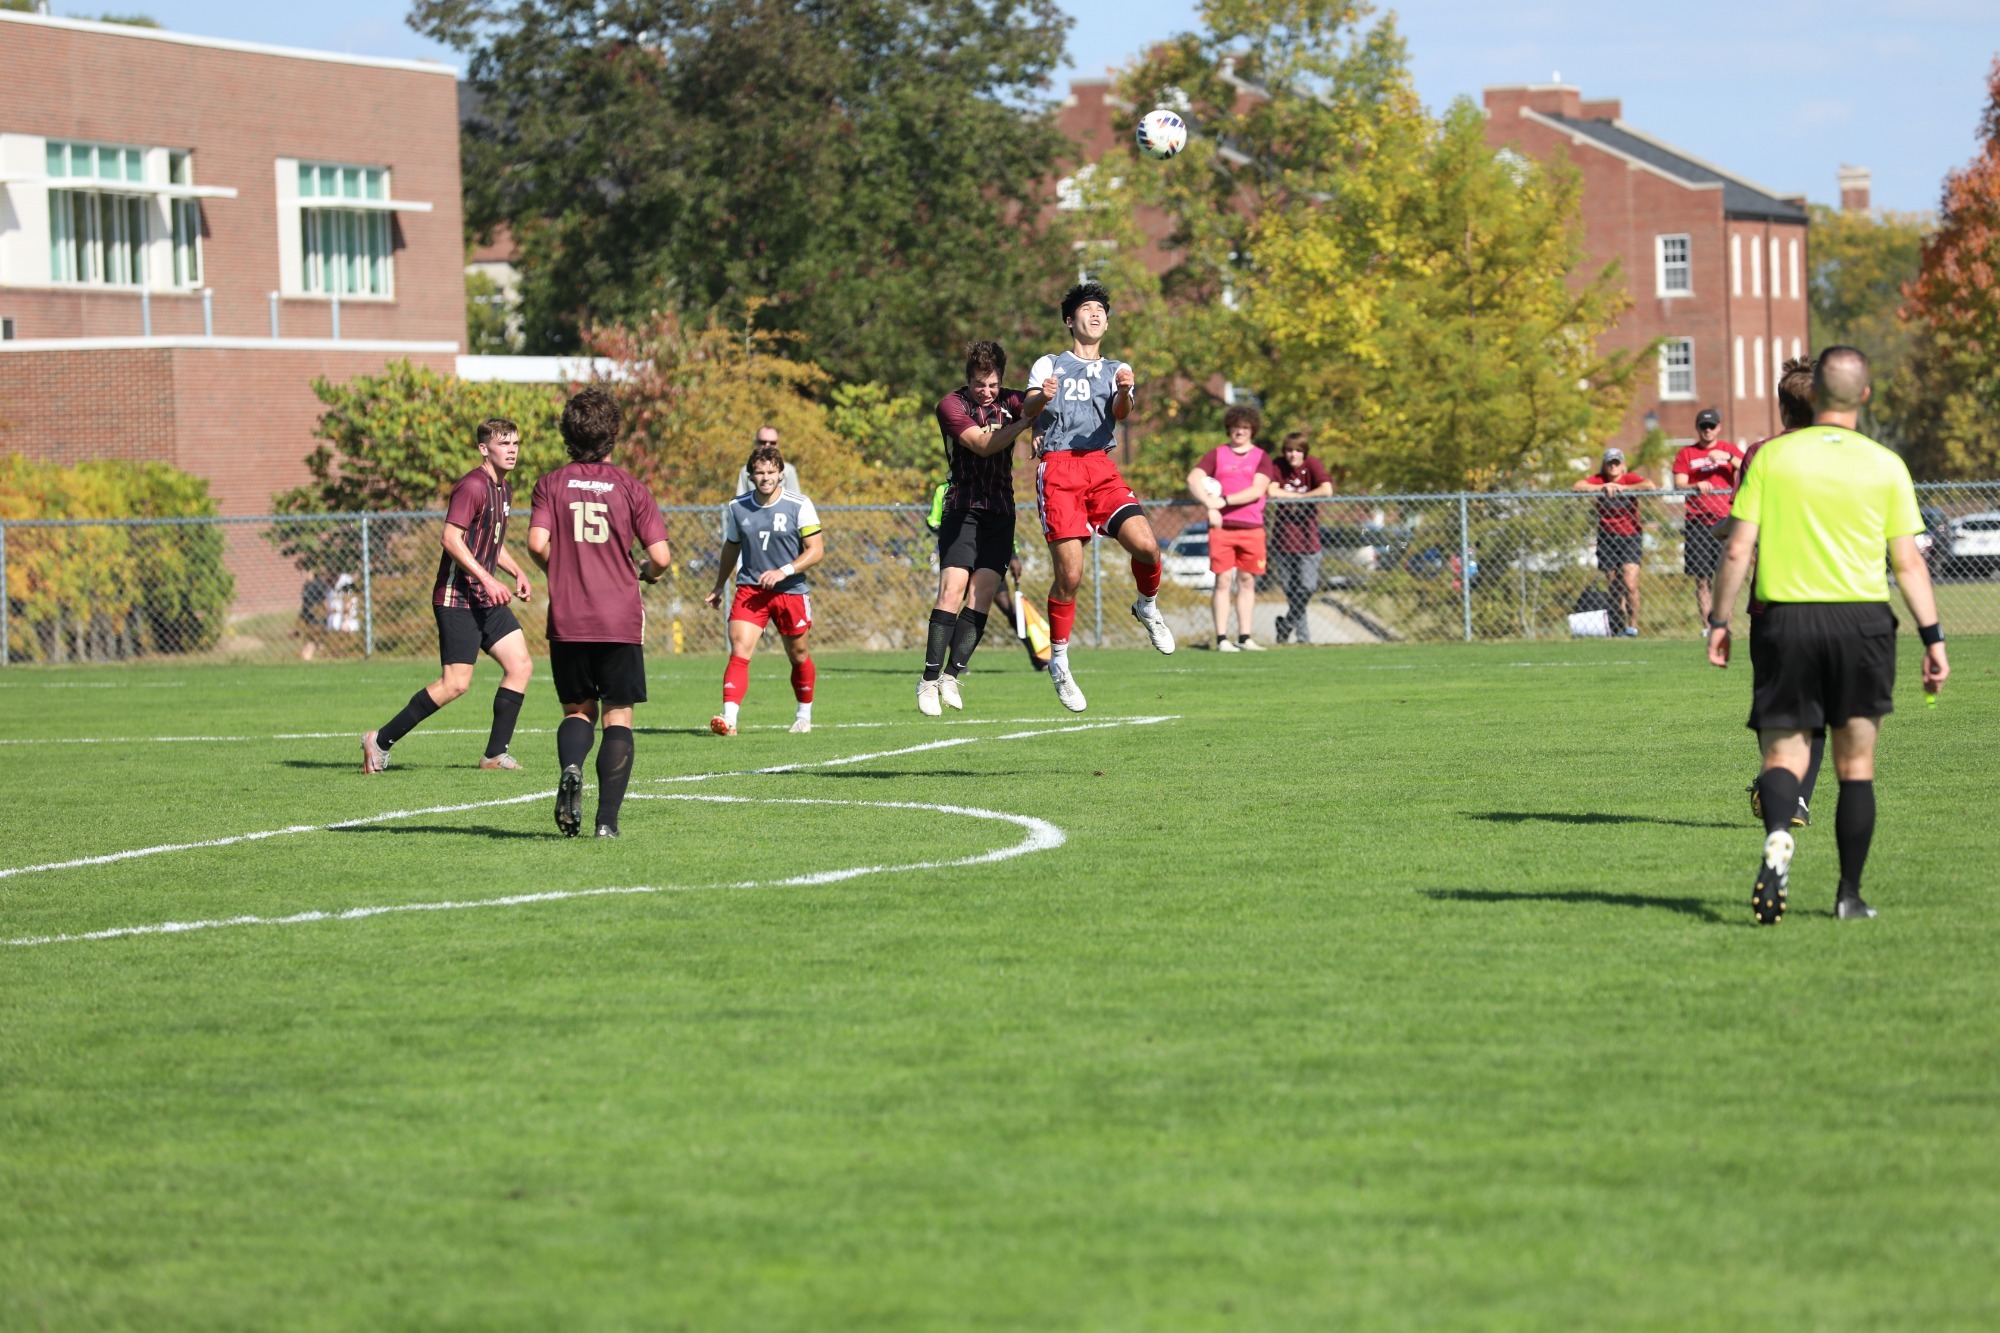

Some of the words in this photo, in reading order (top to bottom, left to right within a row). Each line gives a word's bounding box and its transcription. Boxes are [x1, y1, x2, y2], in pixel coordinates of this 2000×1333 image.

[1086, 361, 1102, 379] R
[1063, 378, 1090, 401] 29
[567, 480, 614, 491] EARLHAM
[569, 502, 609, 543] 15
[773, 513, 787, 532] R
[494, 522, 501, 544] 9
[759, 531, 770, 550] 7
